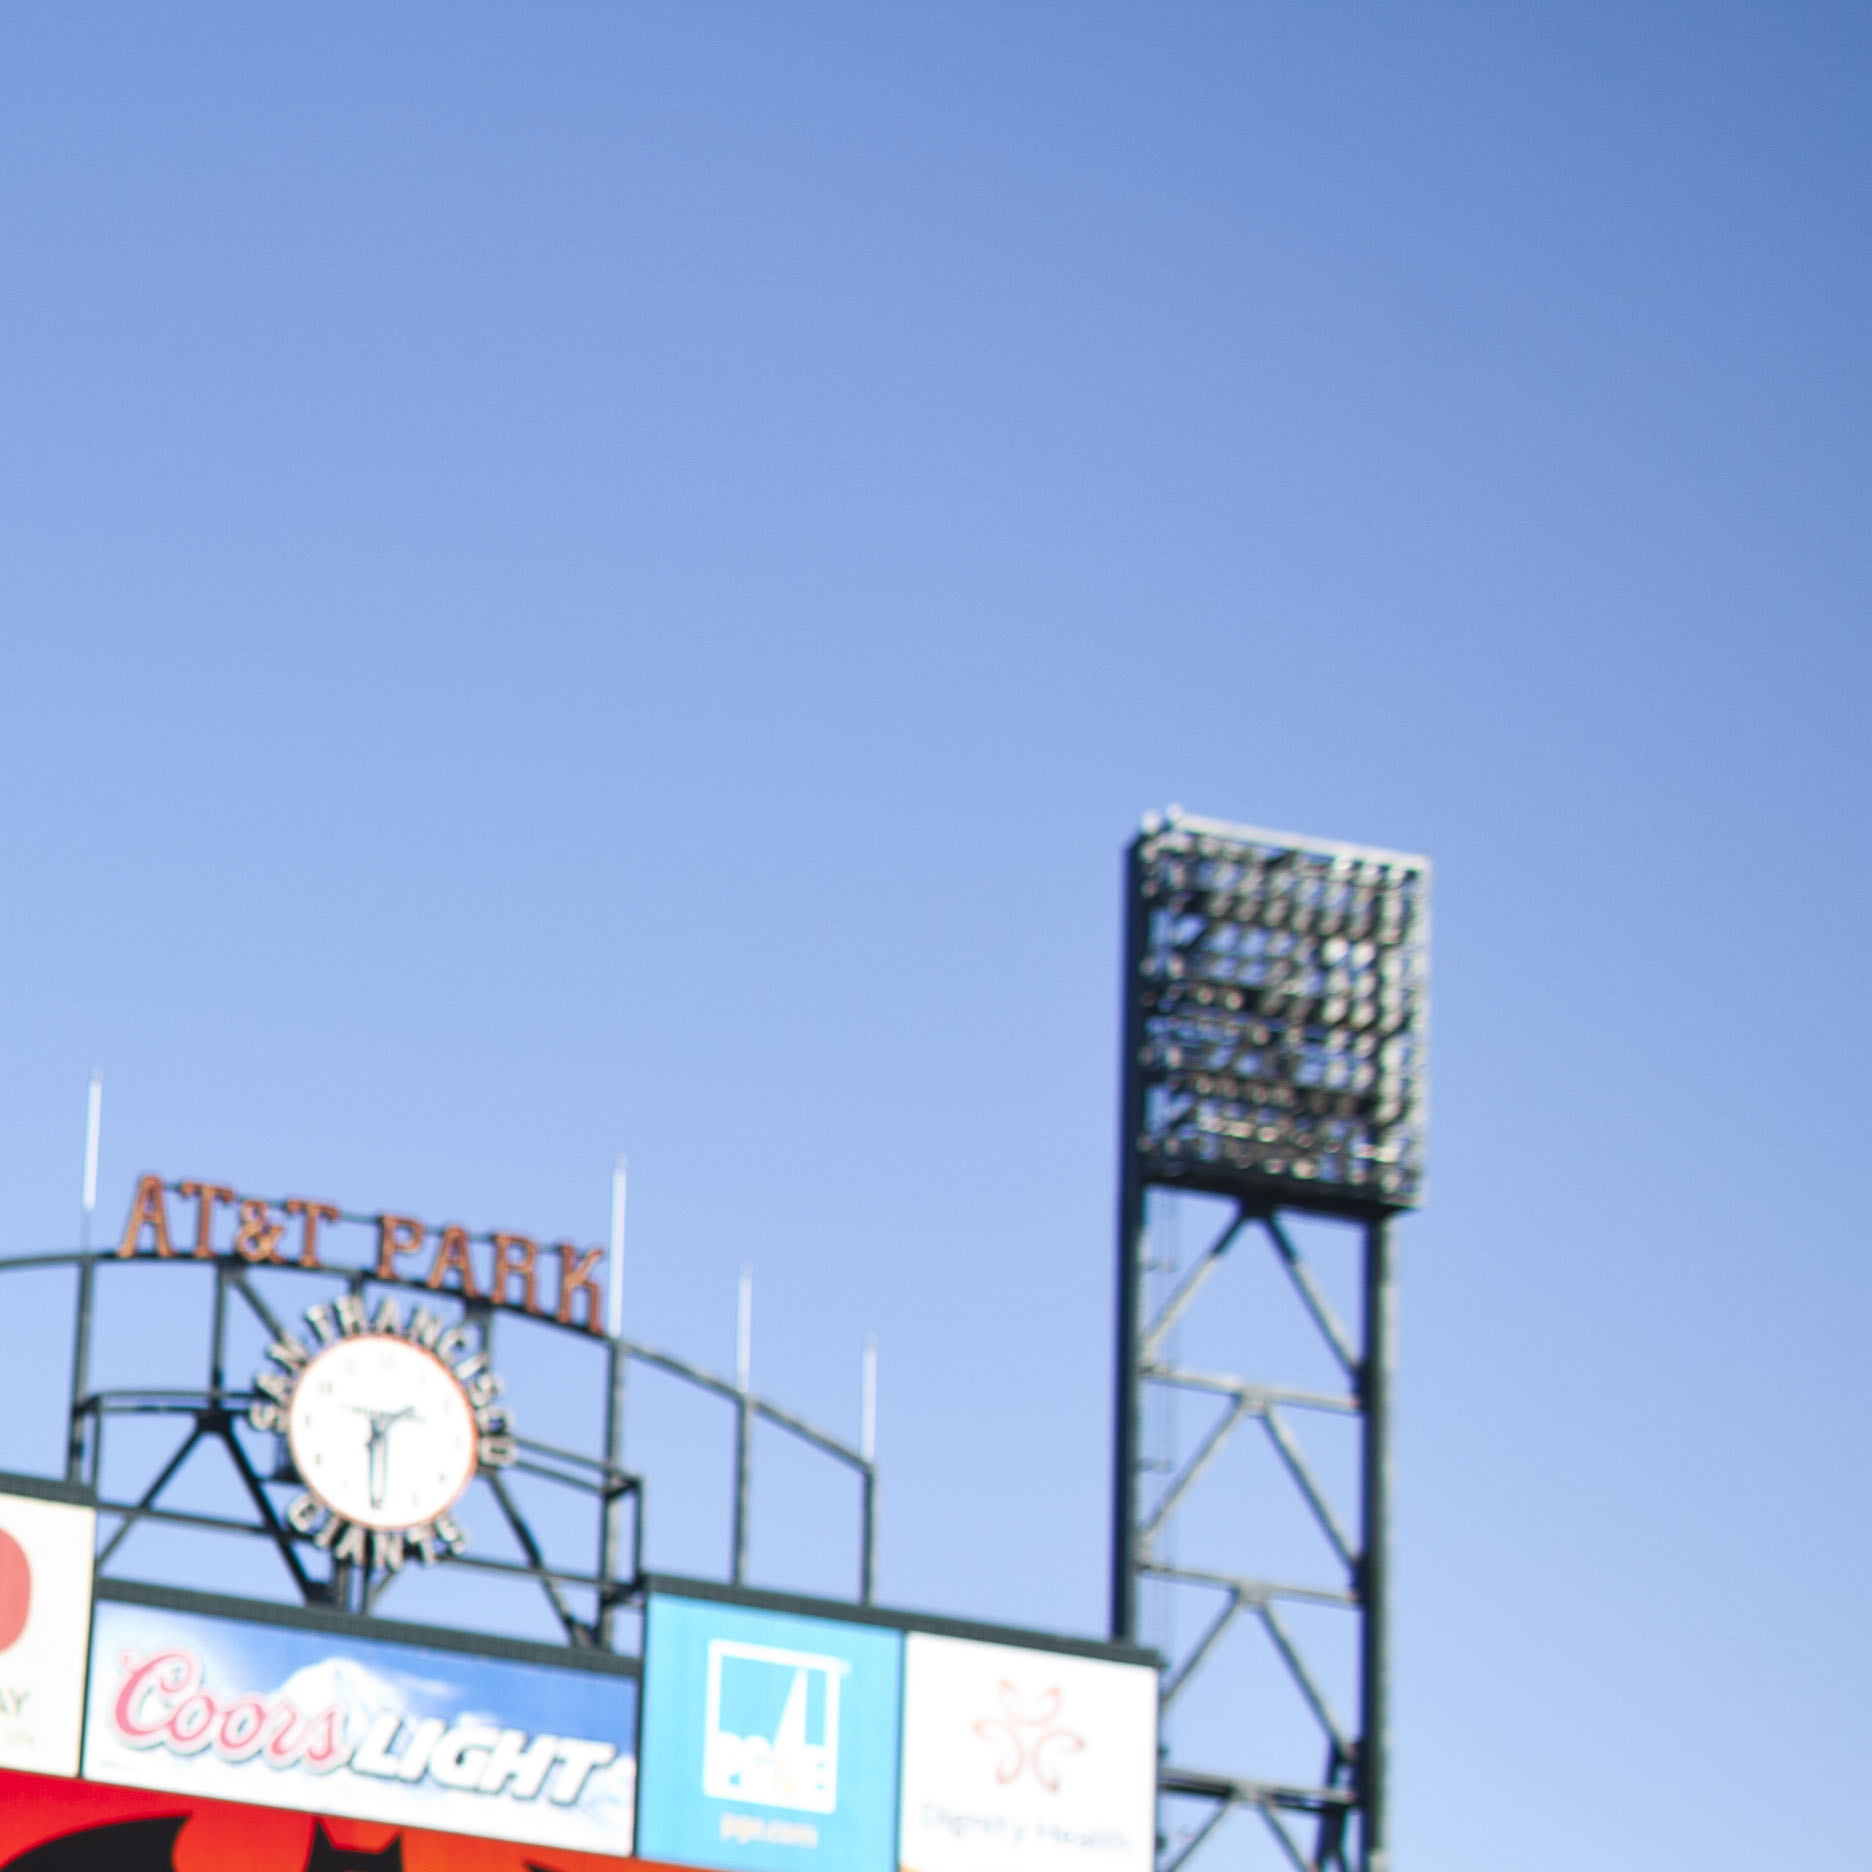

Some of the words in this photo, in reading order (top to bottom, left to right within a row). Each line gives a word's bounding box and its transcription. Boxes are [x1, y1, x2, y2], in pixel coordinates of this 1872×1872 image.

[116, 1174, 339, 1269] AT&T
[375, 1213, 606, 1335] PARK
[249, 1330, 308, 1433] SAN
[304, 1296, 518, 1467] FRANCISCO
[286, 1492, 470, 1572] GIANTS
[112, 1644, 348, 1772] Coors
[350, 1709, 616, 1805] LIGHT
